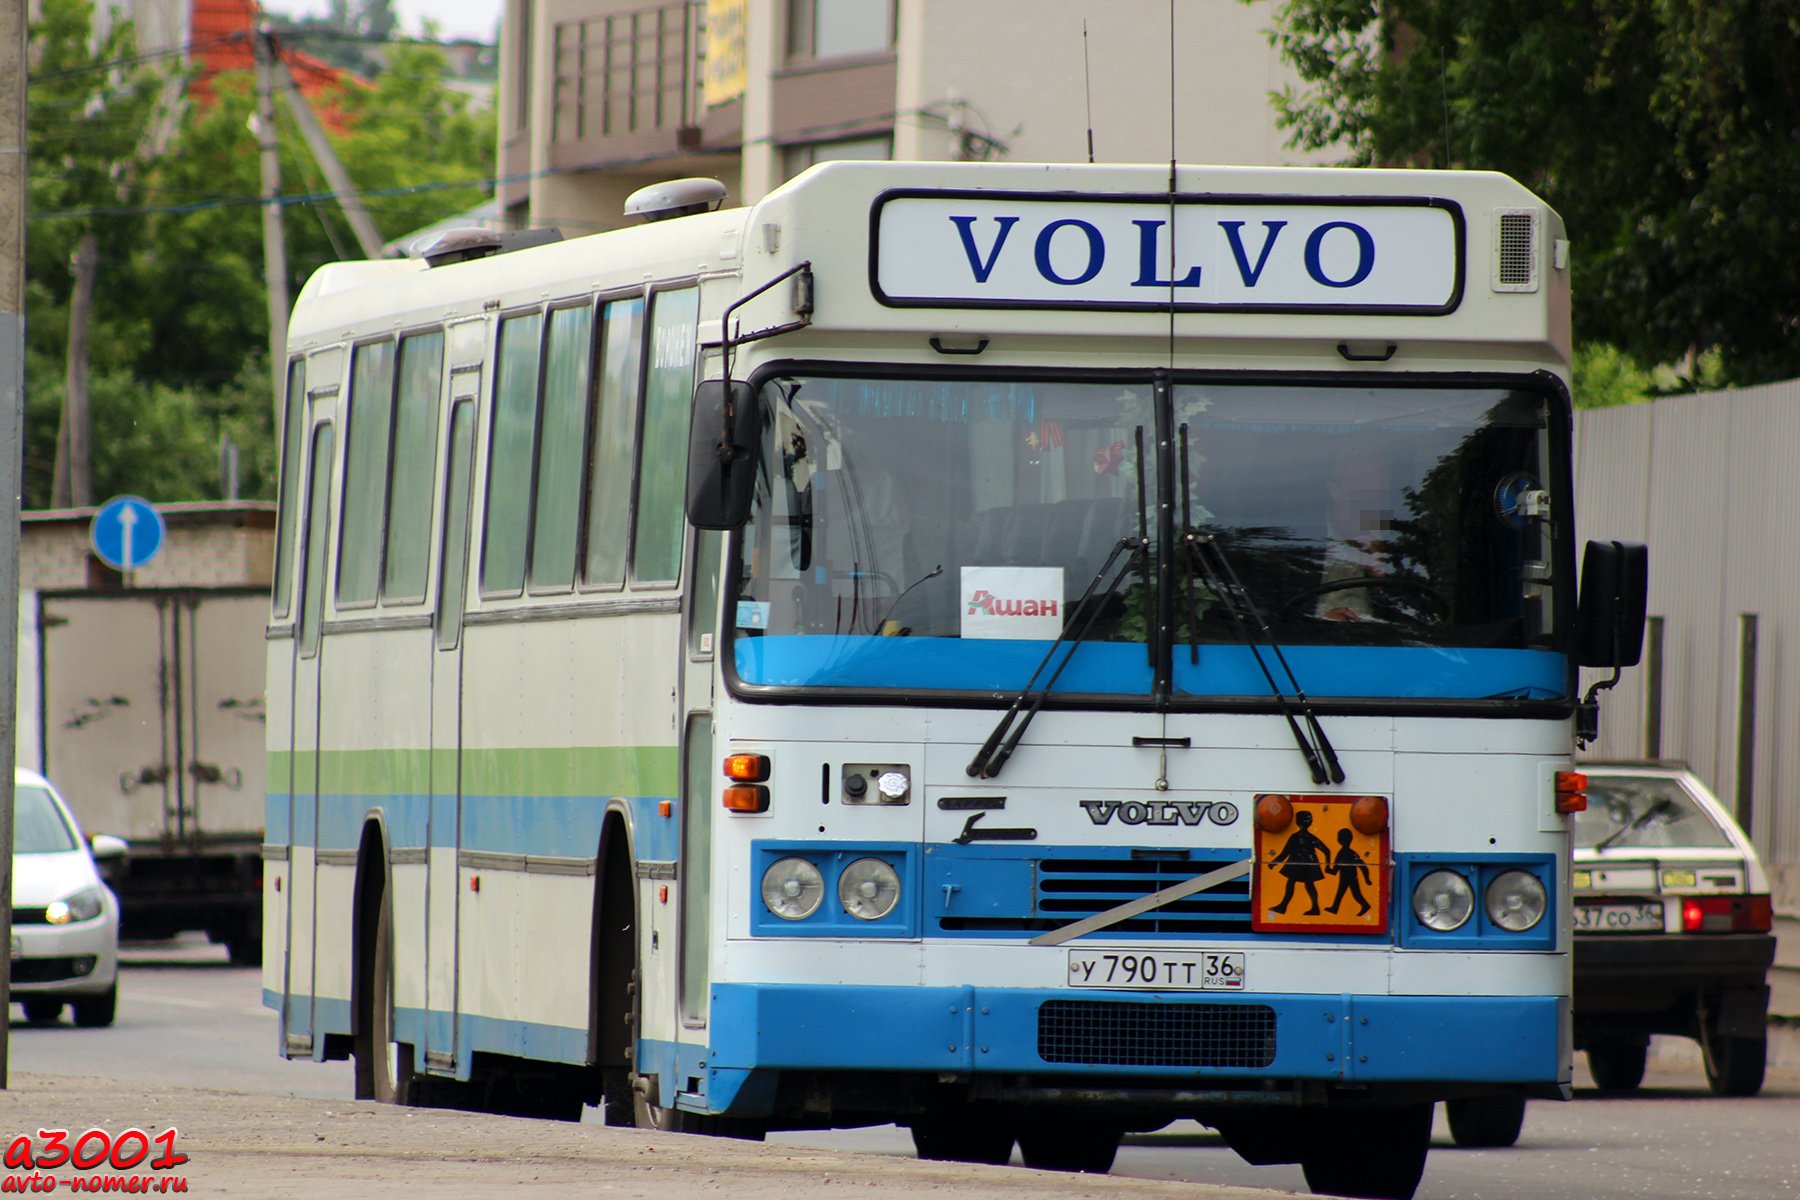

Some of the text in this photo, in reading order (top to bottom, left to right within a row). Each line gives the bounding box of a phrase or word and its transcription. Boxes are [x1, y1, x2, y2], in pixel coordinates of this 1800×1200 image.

[948, 216, 1376, 288] VOLVO
[967, 590, 1058, 616] Ашан
[1079, 800, 1239, 826] VOLVO
[1206, 955, 1234, 976] 36
[1203, 977, 1225, 986] RUS
